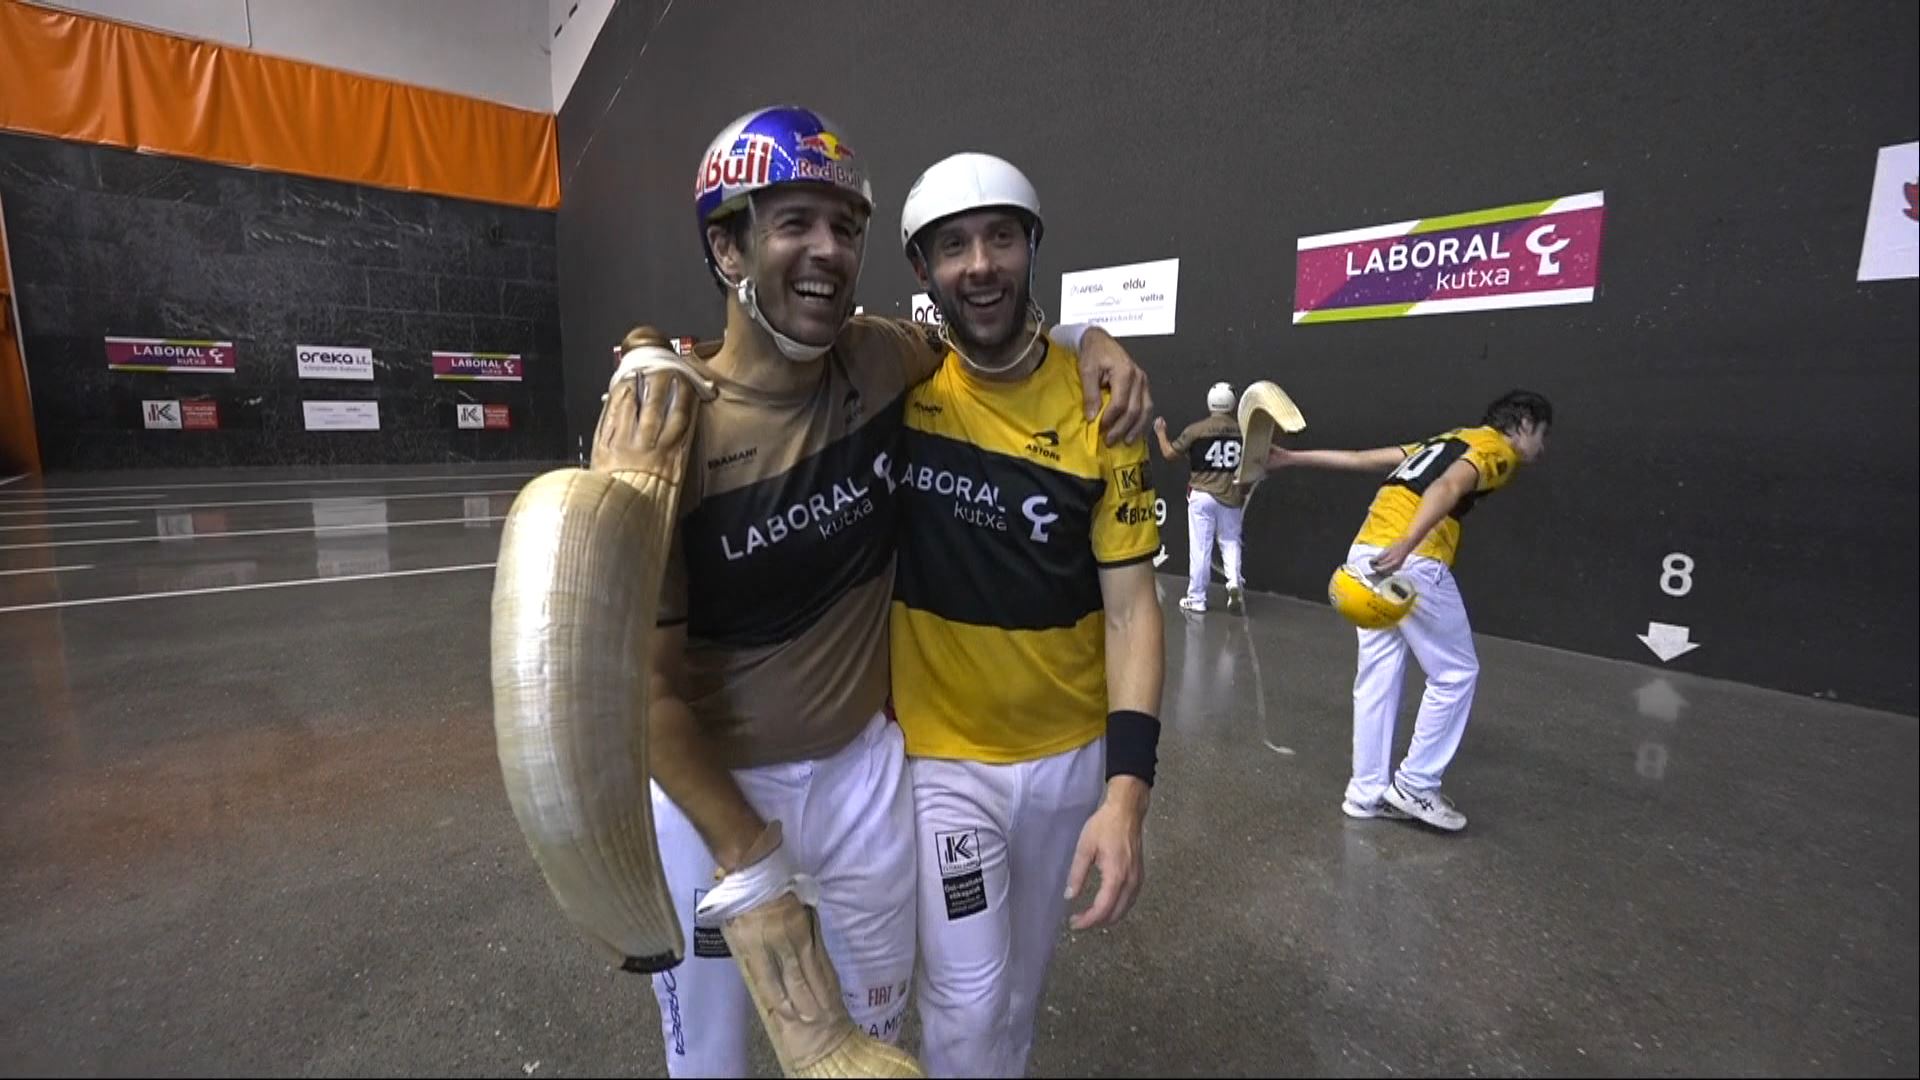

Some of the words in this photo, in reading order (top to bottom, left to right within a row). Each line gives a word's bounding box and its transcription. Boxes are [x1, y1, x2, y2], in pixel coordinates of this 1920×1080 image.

[703, 139, 771, 191] Bull
[799, 159, 832, 180] Red
[1346, 232, 1510, 276] LABORAL
[1122, 278, 1146, 290] eldu
[1436, 267, 1510, 291] kutxa
[915, 305, 942, 323] ore
[133, 345, 204, 357] LABORAL
[300, 351, 353, 365] oreka
[451, 358, 501, 368] LABORAL
[1025, 443, 1061, 462] ASTORE
[1204, 440, 1241, 468] 48
[900, 463, 1006, 513] ABORAL
[721, 477, 869, 560] LABORAL
[818, 498, 874, 540] kutxa
[954, 501, 1007, 531] kutxa
[1154, 498, 1167, 526] 9
[1659, 552, 1695, 597] 8
[868, 984, 893, 1009] FIAT
